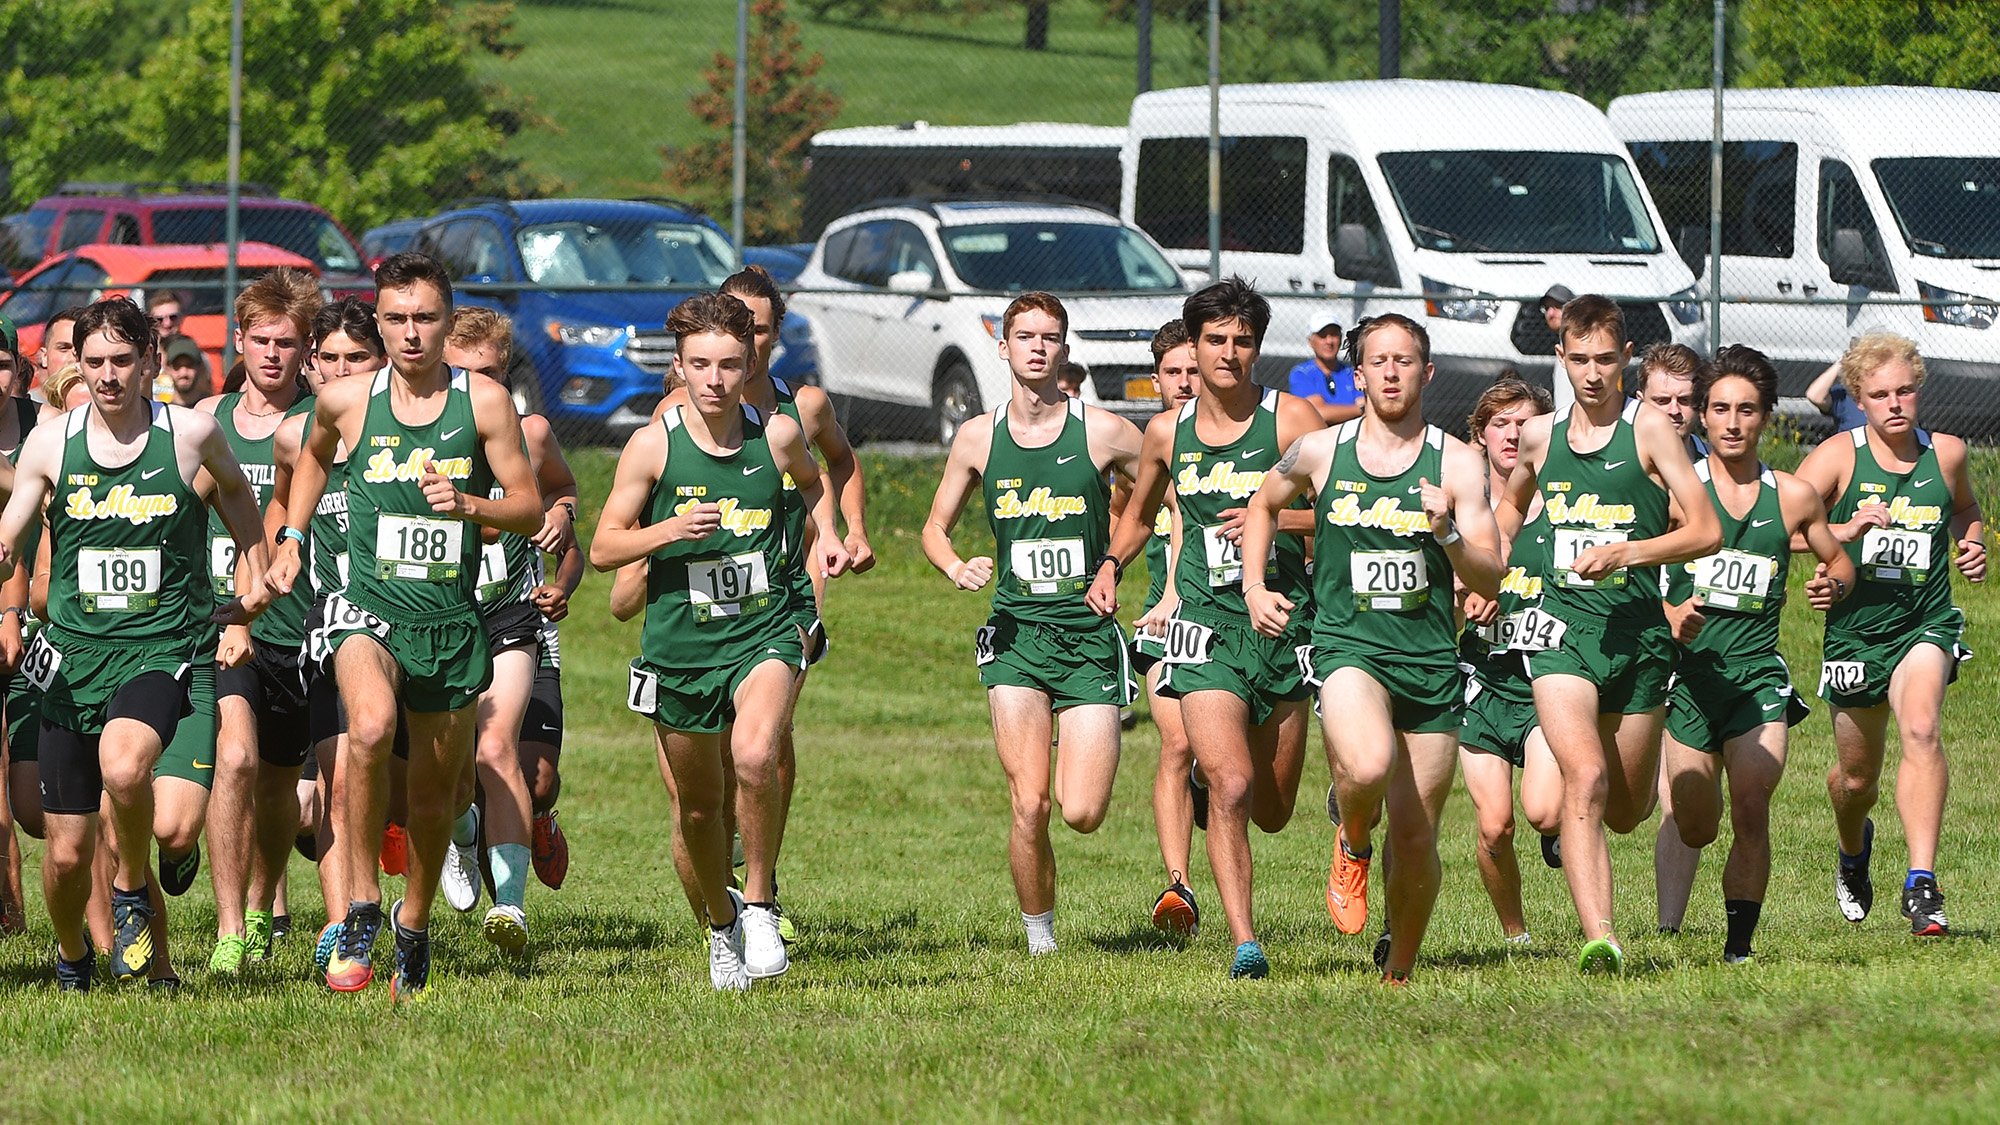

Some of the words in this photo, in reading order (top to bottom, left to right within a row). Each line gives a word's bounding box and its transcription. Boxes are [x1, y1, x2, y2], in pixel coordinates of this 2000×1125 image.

[363, 448, 397, 483] Le
[1177, 463, 1200, 496] Le
[65, 486, 96, 520] Le
[96, 484, 178, 526] Moyne
[994, 489, 1023, 519] Le
[1022, 486, 1087, 522] Moyne
[1327, 493, 1360, 526] Le
[1546, 492, 1569, 525] Le
[1568, 493, 1636, 529] Moyne
[397, 526, 448, 562] 188
[1875, 537, 1919, 567] 202
[97, 559, 147, 592] 189
[706, 562, 753, 600] 197
[1027, 547, 1072, 579] 190
[1367, 560, 1417, 592] 203
[1709, 557, 1758, 594] 204
[24, 636, 53, 683] 89
[633, 671, 648, 707] 7
